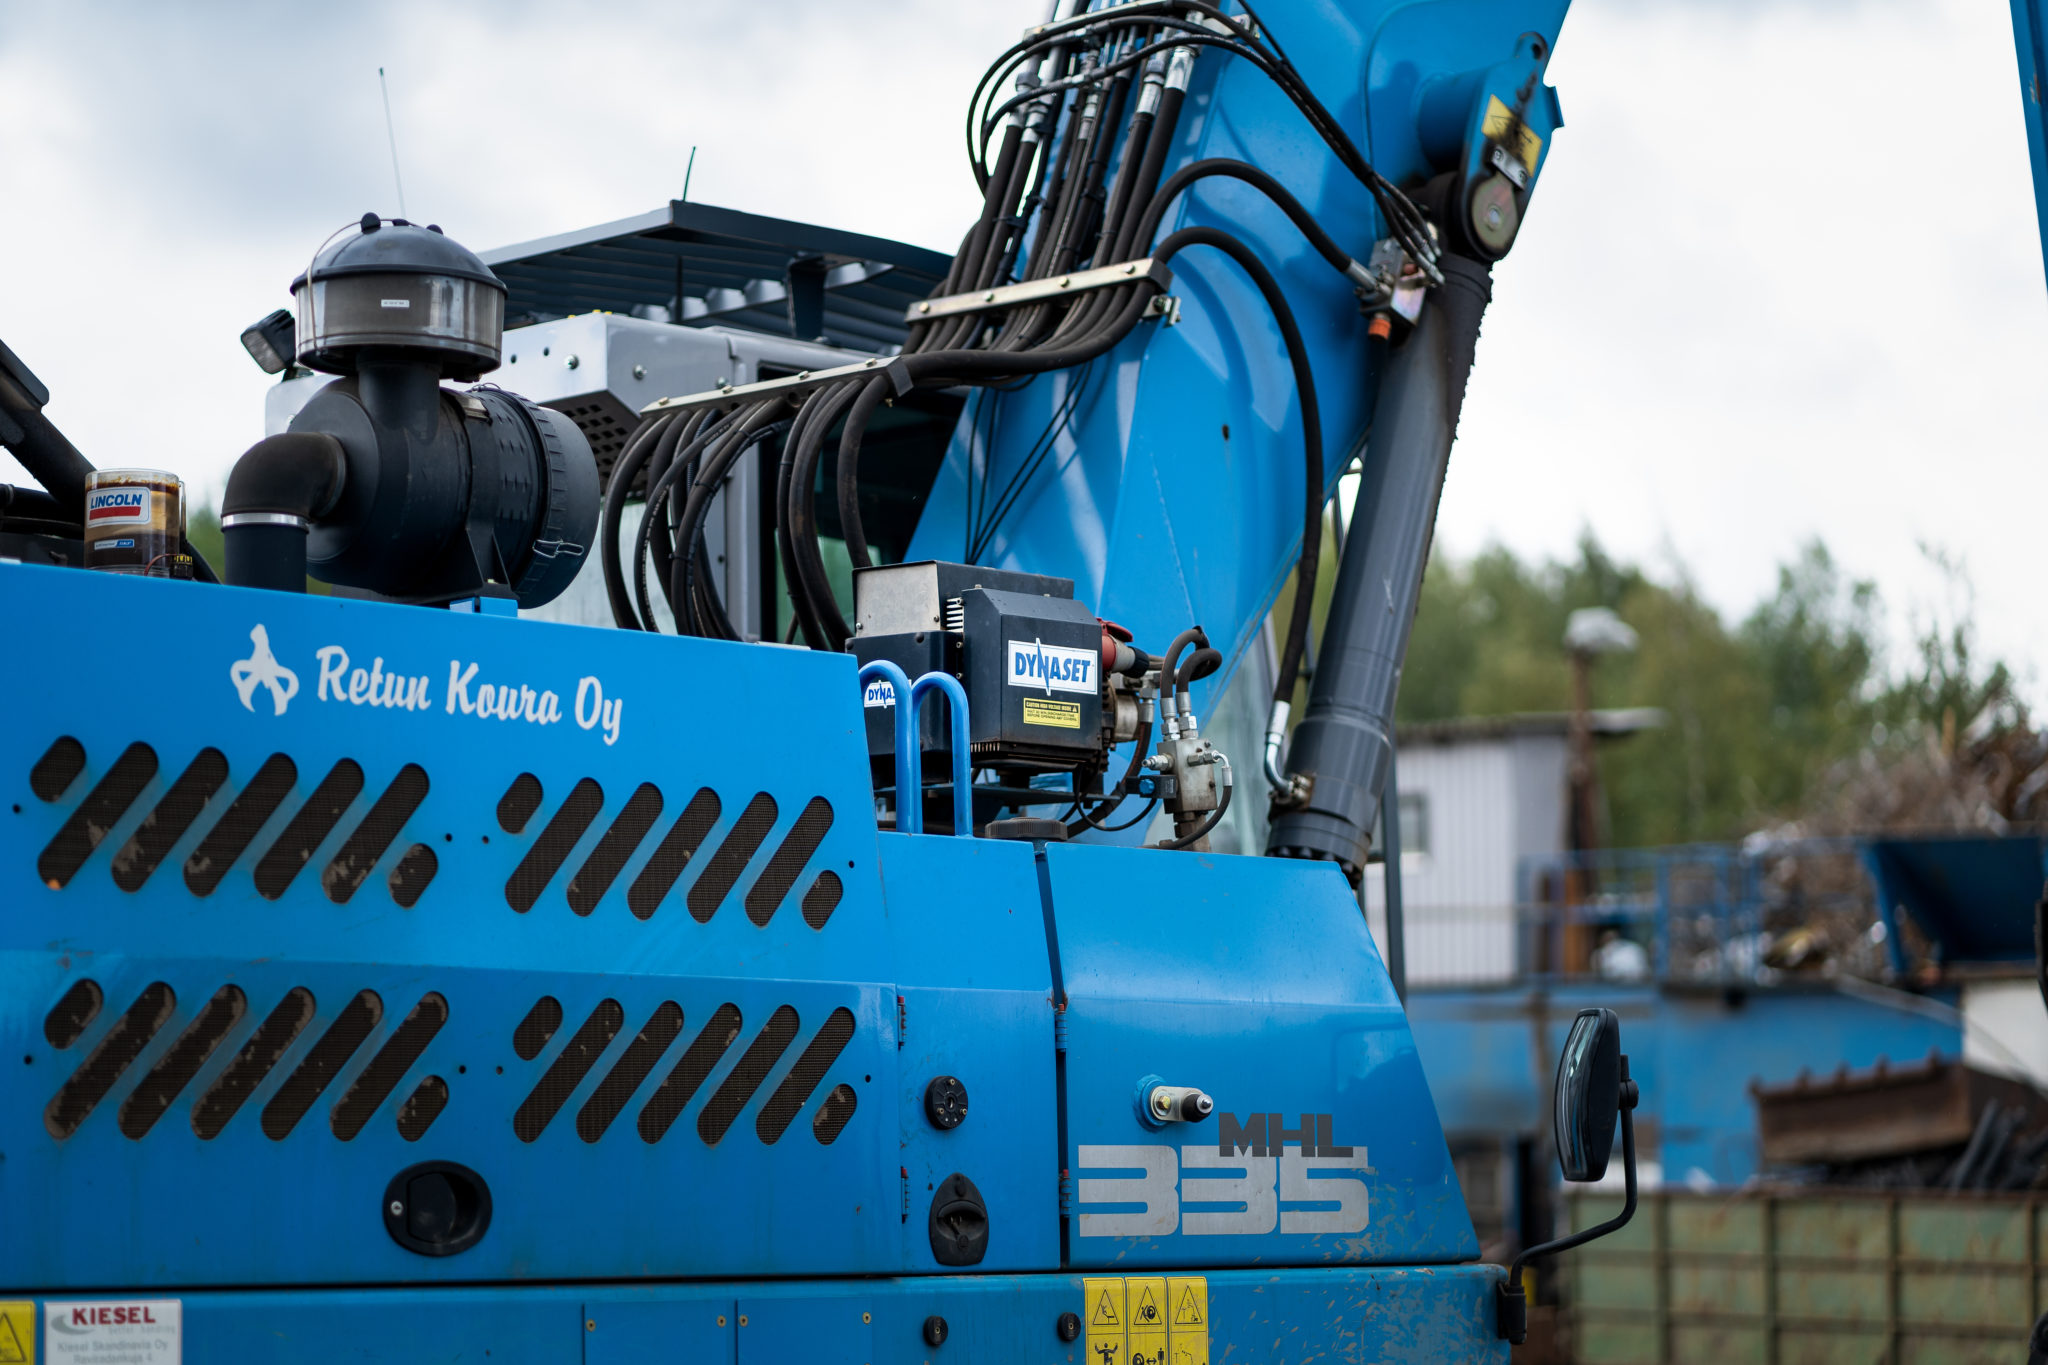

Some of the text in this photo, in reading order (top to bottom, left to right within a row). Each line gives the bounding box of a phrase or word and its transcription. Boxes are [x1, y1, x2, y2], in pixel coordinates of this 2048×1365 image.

[90, 493, 143, 510] LINCOLN
[1015, 643, 1091, 691] DYNASET
[315, 645, 623, 746] Retun Koura Oy
[868, 683, 896, 704] DYNA
[1218, 1112, 1354, 1158] MHL
[1078, 1144, 1370, 1237] 335
[72, 1306, 156, 1326] KIESEL
[57, 1341, 88, 1353] Kiesel
[154, 1338, 168, 1351] Oy
